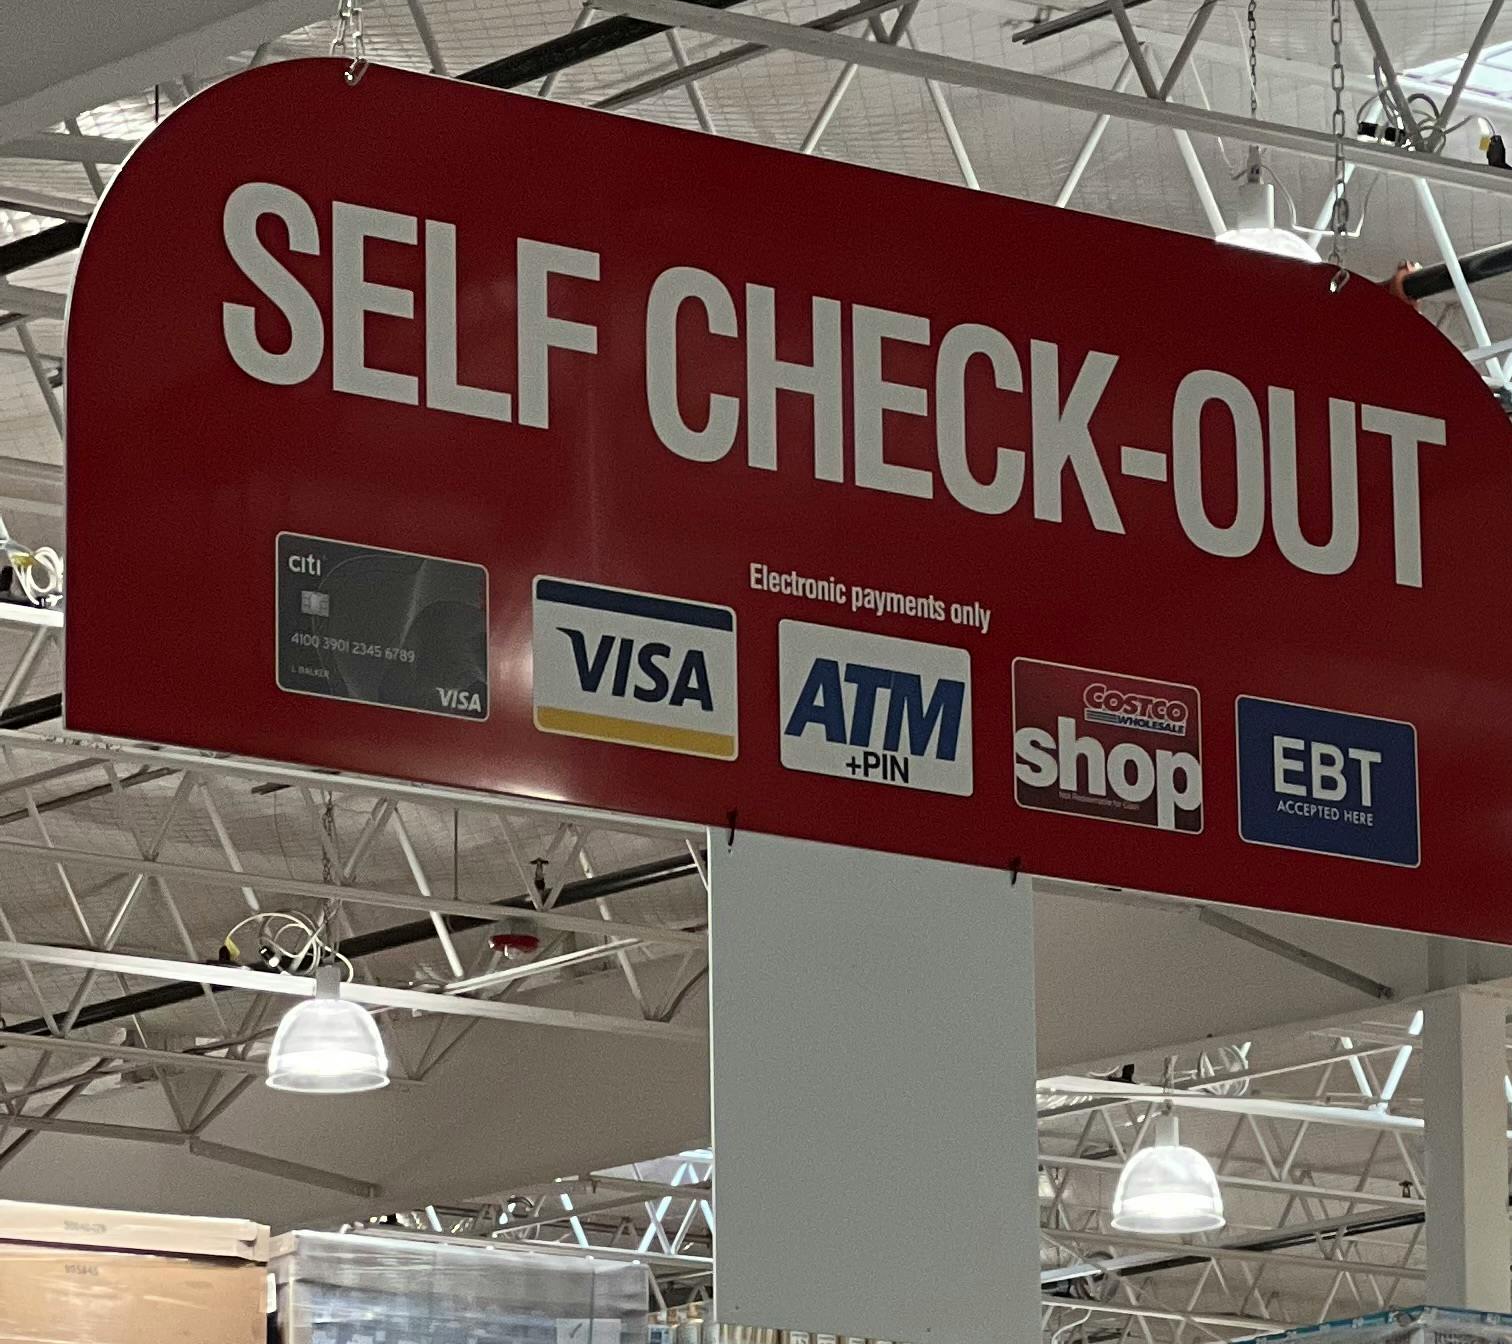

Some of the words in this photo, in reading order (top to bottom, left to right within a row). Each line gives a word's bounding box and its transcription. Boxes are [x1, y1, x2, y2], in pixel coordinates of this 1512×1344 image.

[222, 181, 600, 429] SELF
[645, 265, 1447, 588] CHECK-OUT
[288, 554, 321, 576] citi
[749, 561, 847, 604] Electronic
[851, 585, 945, 621] payments
[950, 602, 991, 634] only
[352, 642, 382, 658] 2345
[385, 647, 415, 663] 6789
[556, 626, 714, 712] VISA
[435, 687, 482, 712] VISA
[784, 657, 966, 762] ATM
[1083, 683, 1188, 723] COSTCO
[1117, 715, 1185, 735] WHOLESALE
[845, 751, 910, 784] +PIN
[1014, 716, 1201, 829] shop
[1273, 735, 1382, 807] EBT
[1277, 800, 1340, 821] ACCEPTED
[1344, 809, 1374, 827] HERE
